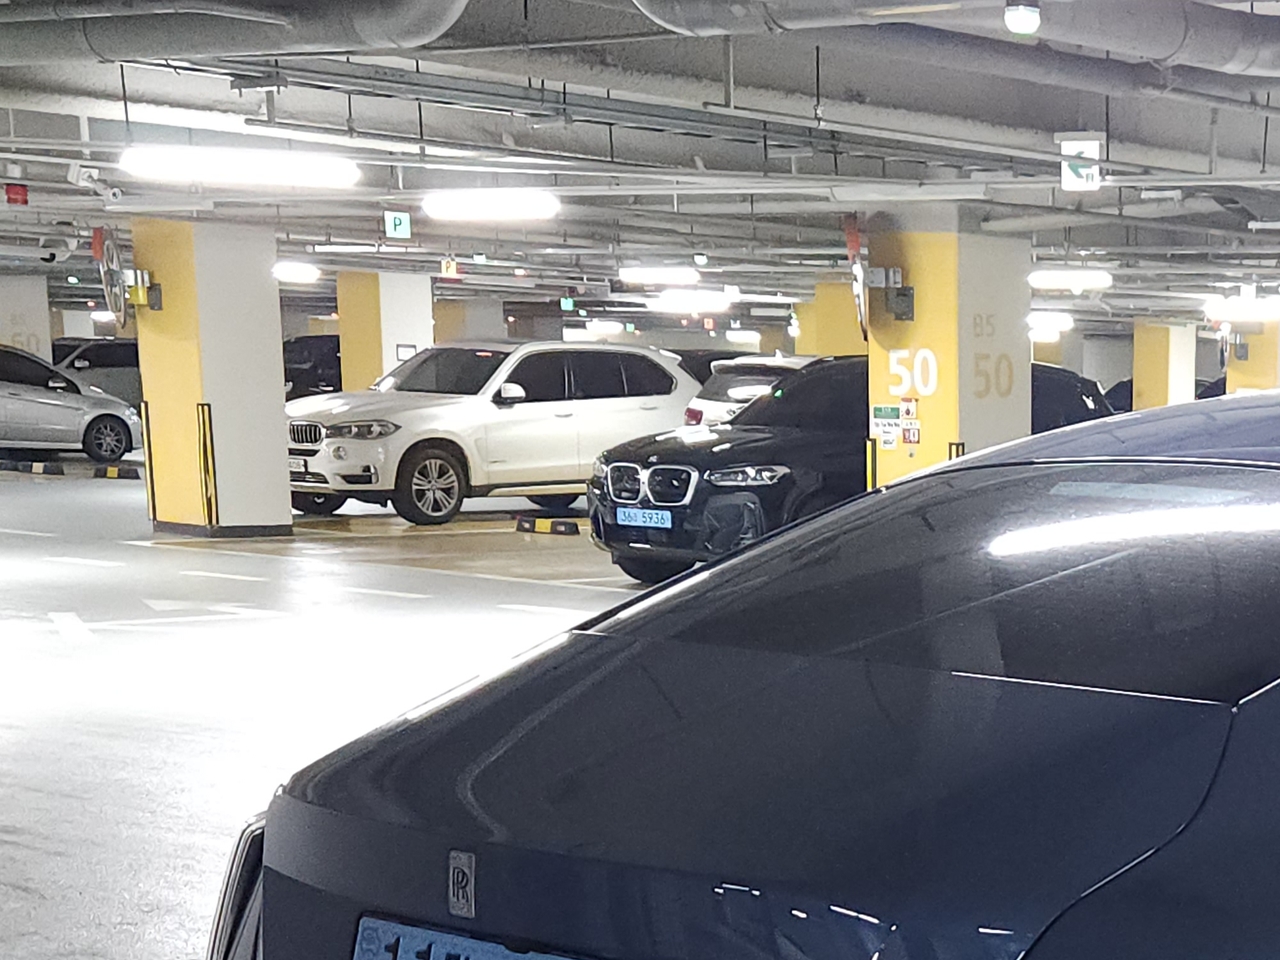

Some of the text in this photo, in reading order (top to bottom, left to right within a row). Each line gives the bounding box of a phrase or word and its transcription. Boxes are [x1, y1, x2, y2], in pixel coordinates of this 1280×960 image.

[393, 216, 402, 232] P
[888, 347, 938, 397] 50
[974, 352, 1014, 399] 50
[641, 511, 666, 525] 5936
